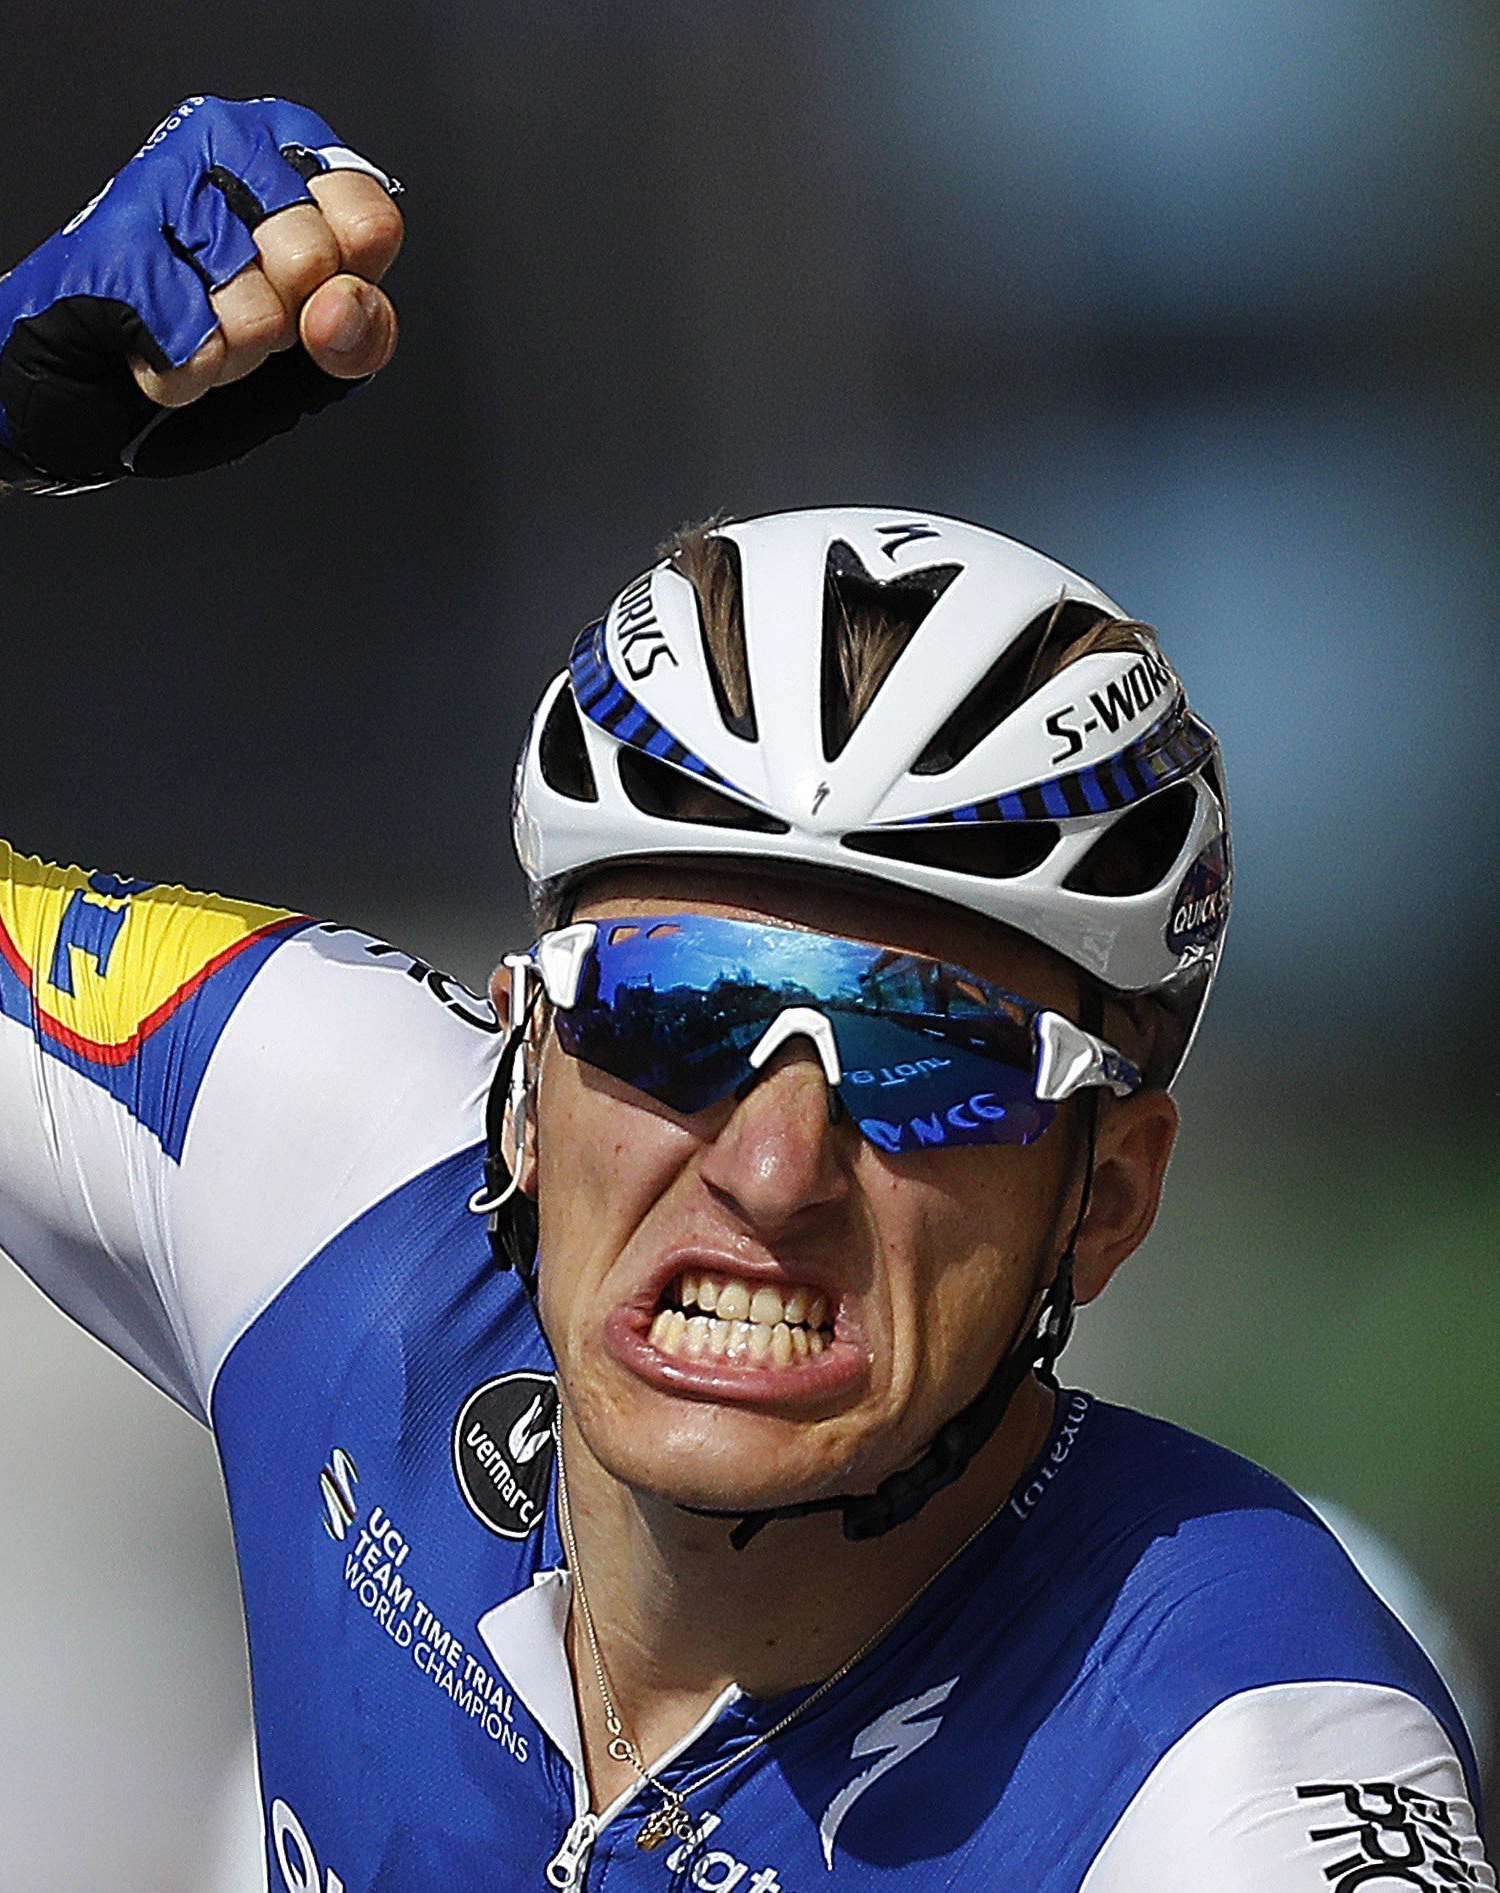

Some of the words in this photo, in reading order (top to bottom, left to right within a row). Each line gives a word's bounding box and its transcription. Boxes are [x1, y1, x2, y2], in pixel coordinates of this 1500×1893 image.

[617, 573, 678, 681] ORKS
[1045, 654, 1172, 765] S-WOR
[466, 1422, 534, 1523] vermarc
[369, 1507, 409, 1567] UCI
[345, 1554, 413, 1648] WORLD
[414, 1642, 529, 1764] CHAMPIONS
[355, 1530, 414, 1613] TEAM
[413, 1600, 463, 1668] TIME
[463, 1655, 514, 1723] TRIAL
